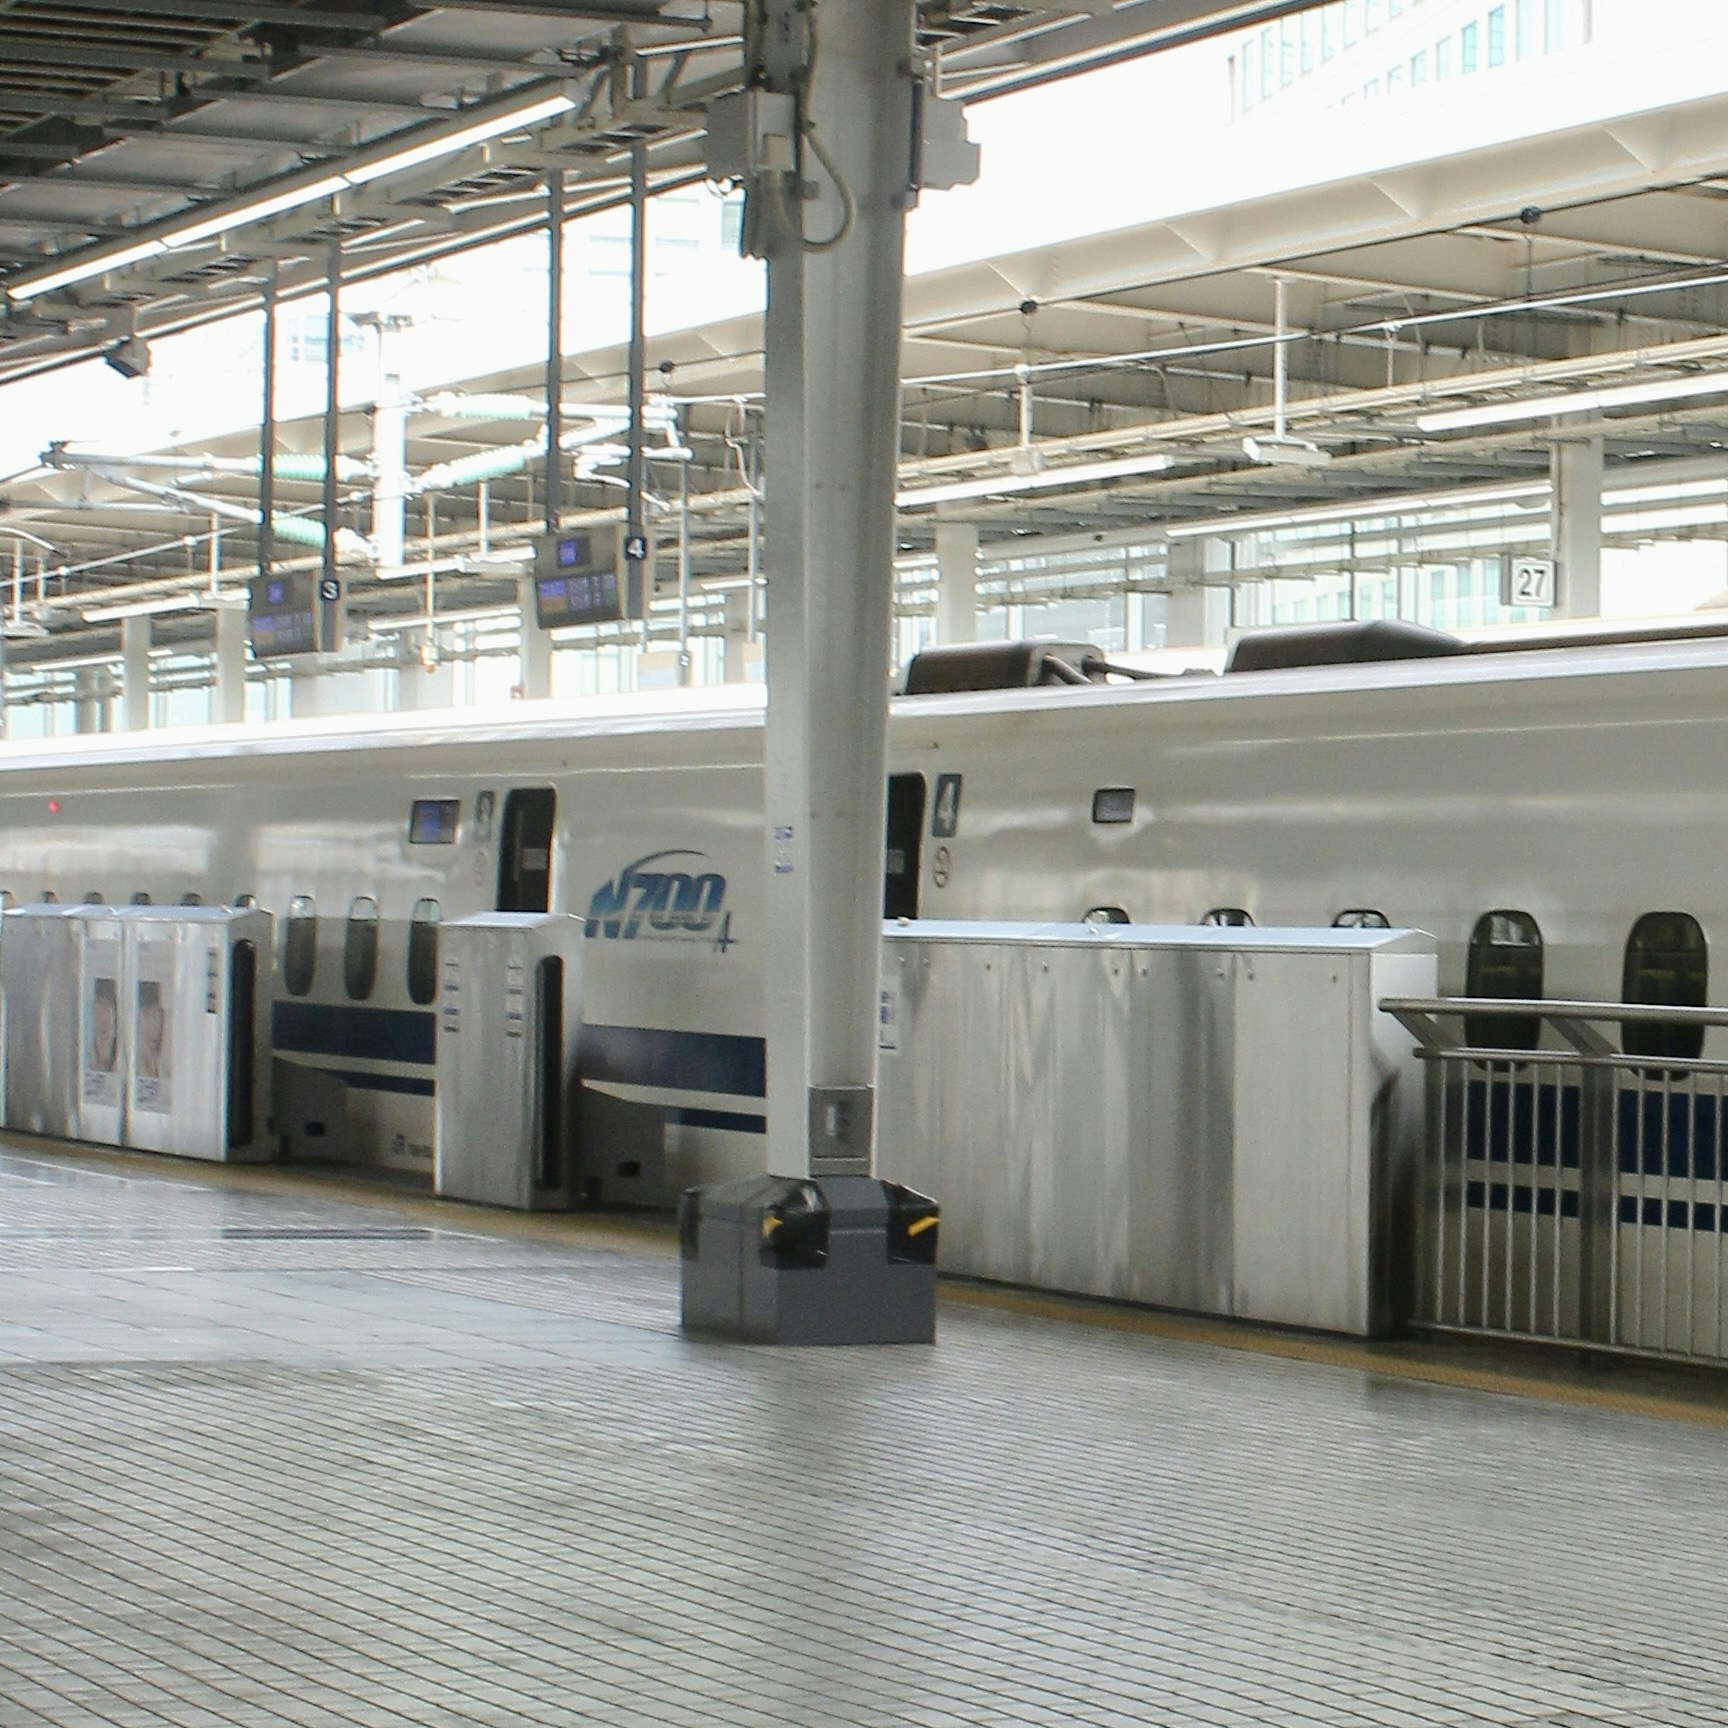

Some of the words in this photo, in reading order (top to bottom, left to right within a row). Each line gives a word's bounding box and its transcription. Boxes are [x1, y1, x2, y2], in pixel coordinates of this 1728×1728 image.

[627, 537, 645, 559] 4
[1519, 568, 1546, 597] 27
[938, 781, 955, 829] 4
